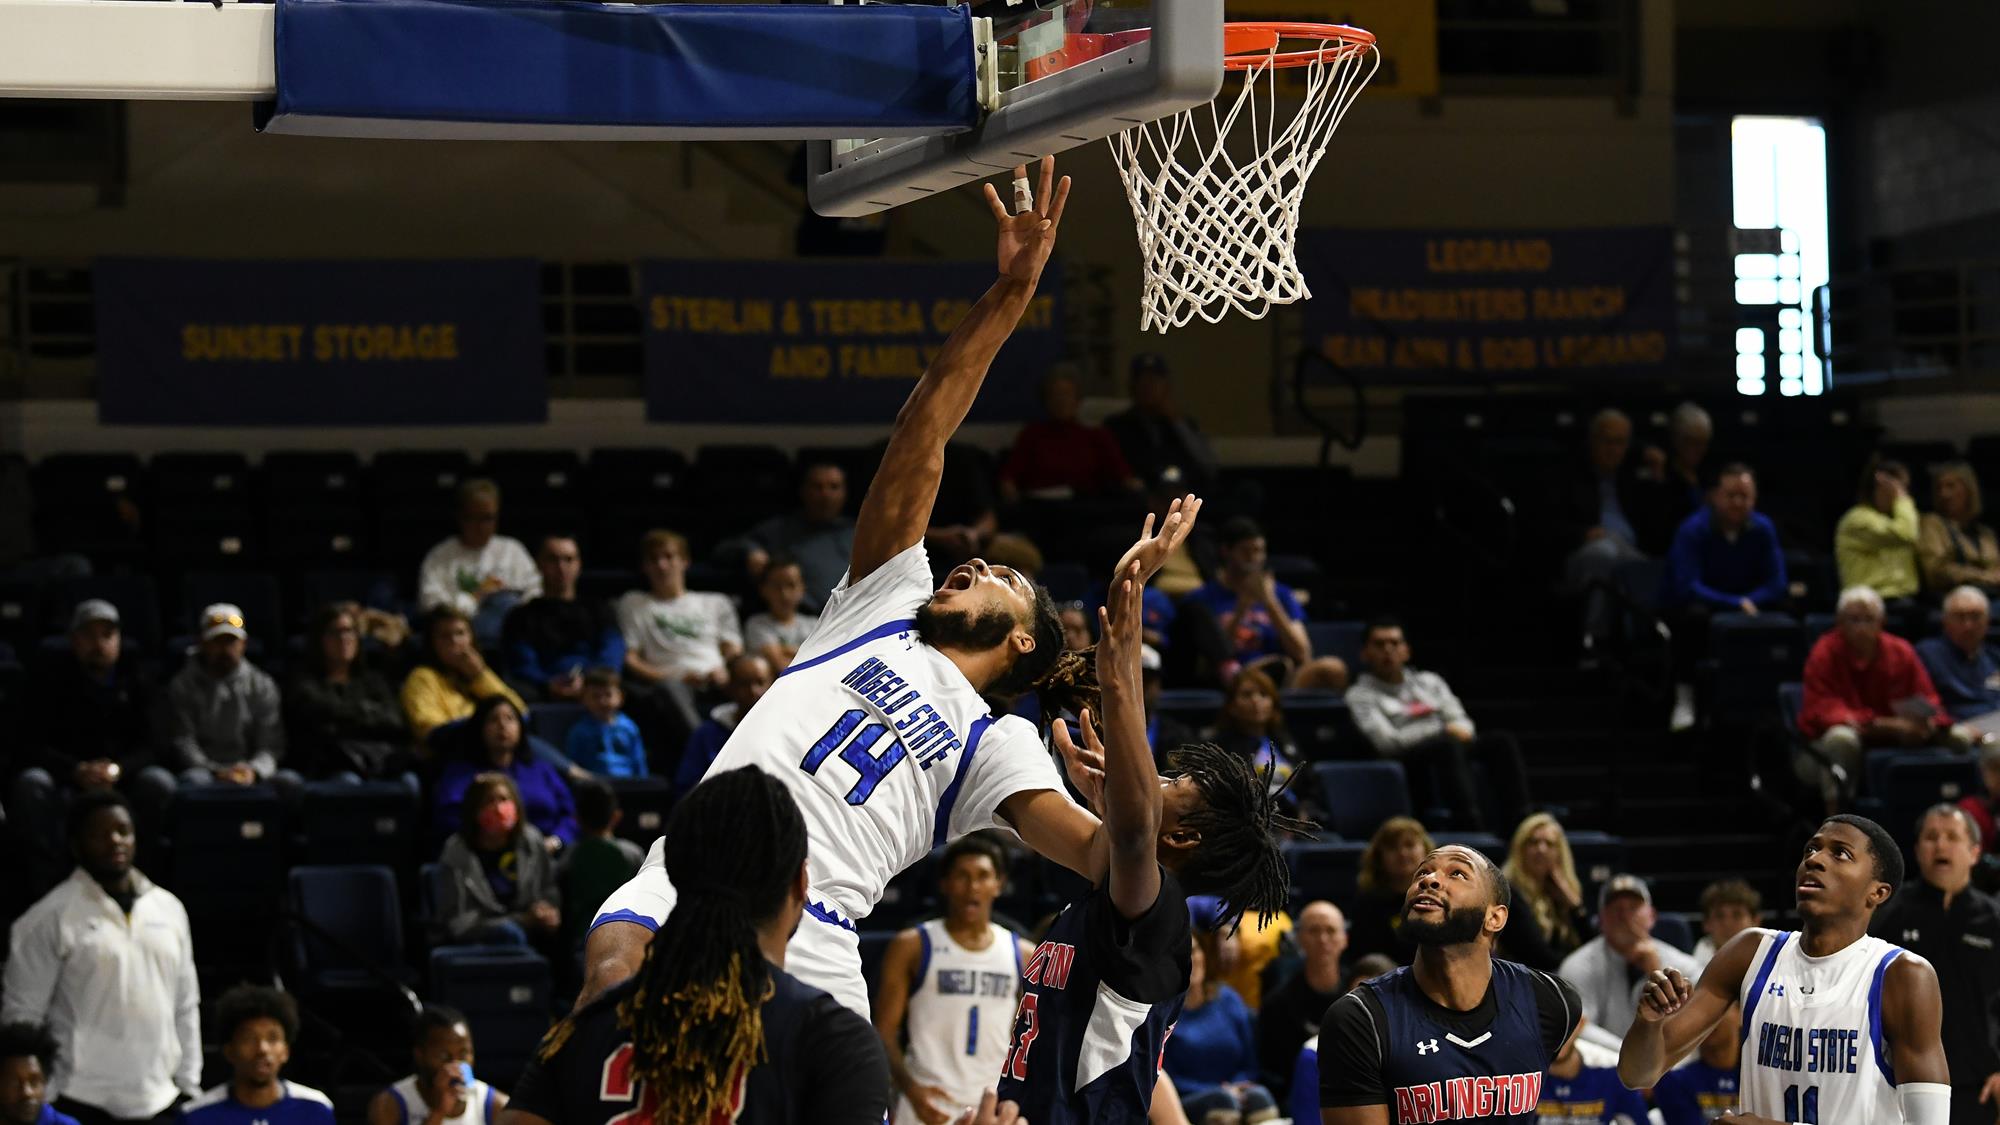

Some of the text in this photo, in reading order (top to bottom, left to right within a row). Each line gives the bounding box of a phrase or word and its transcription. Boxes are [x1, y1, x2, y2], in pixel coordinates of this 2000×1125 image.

[1426, 240, 1552, 272] LEGRAND
[650, 296, 773, 335] STERLIN
[780, 298, 800, 335] &
[811, 299, 925, 336] TERESA
[1532, 286, 1626, 319] RANCH
[182, 323, 459, 361] SUNSET STORAGE
[769, 344, 831, 379] AND
[1455, 337, 1476, 370] &
[1480, 337, 1538, 370] BOB
[841, 656, 962, 771] ANGELO STATE
[799, 709, 908, 806] 14
[966, 1005, 979, 1056] 1
[1757, 1022, 1858, 1073] ANGELO STATE
[1393, 1070, 1543, 1125] ARLINGTON
[1784, 1084, 1819, 1125] 11
